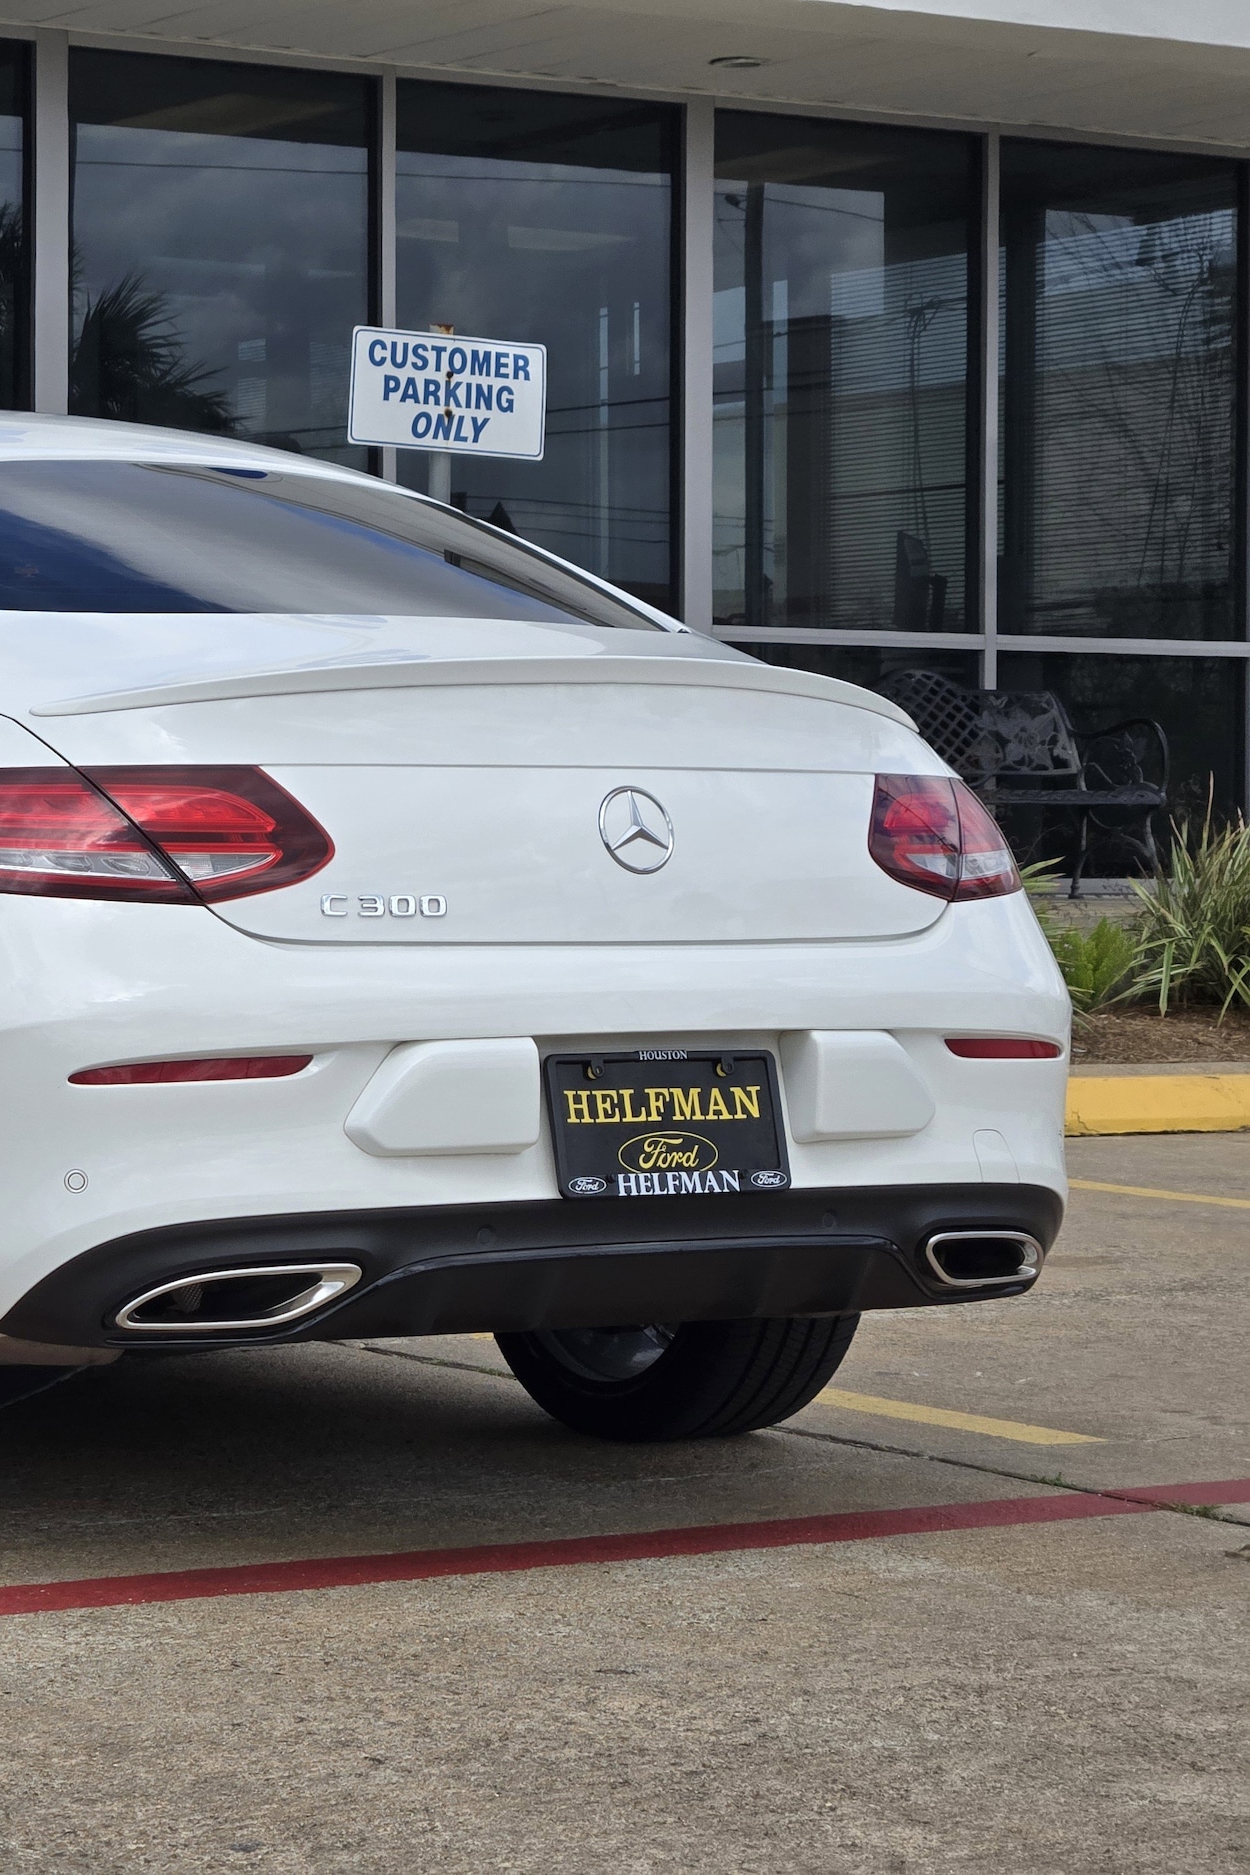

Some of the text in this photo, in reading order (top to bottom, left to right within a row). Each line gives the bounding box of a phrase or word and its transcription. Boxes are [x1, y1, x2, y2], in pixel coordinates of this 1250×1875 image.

[368, 339, 531, 381] CUSTOMER
[382, 374, 515, 414] PARKING
[411, 411, 491, 444] ONLY
[320, 894, 447, 917] C 300
[639, 1050, 688, 1061] HOUSTON
[563, 1085, 761, 1123] HELFMAN
[638, 1137, 700, 1169] Ford
[575, 1179, 599, 1191] Ford
[617, 1169, 741, 1196] HELFMAN
[757, 1173, 780, 1185] Ford
